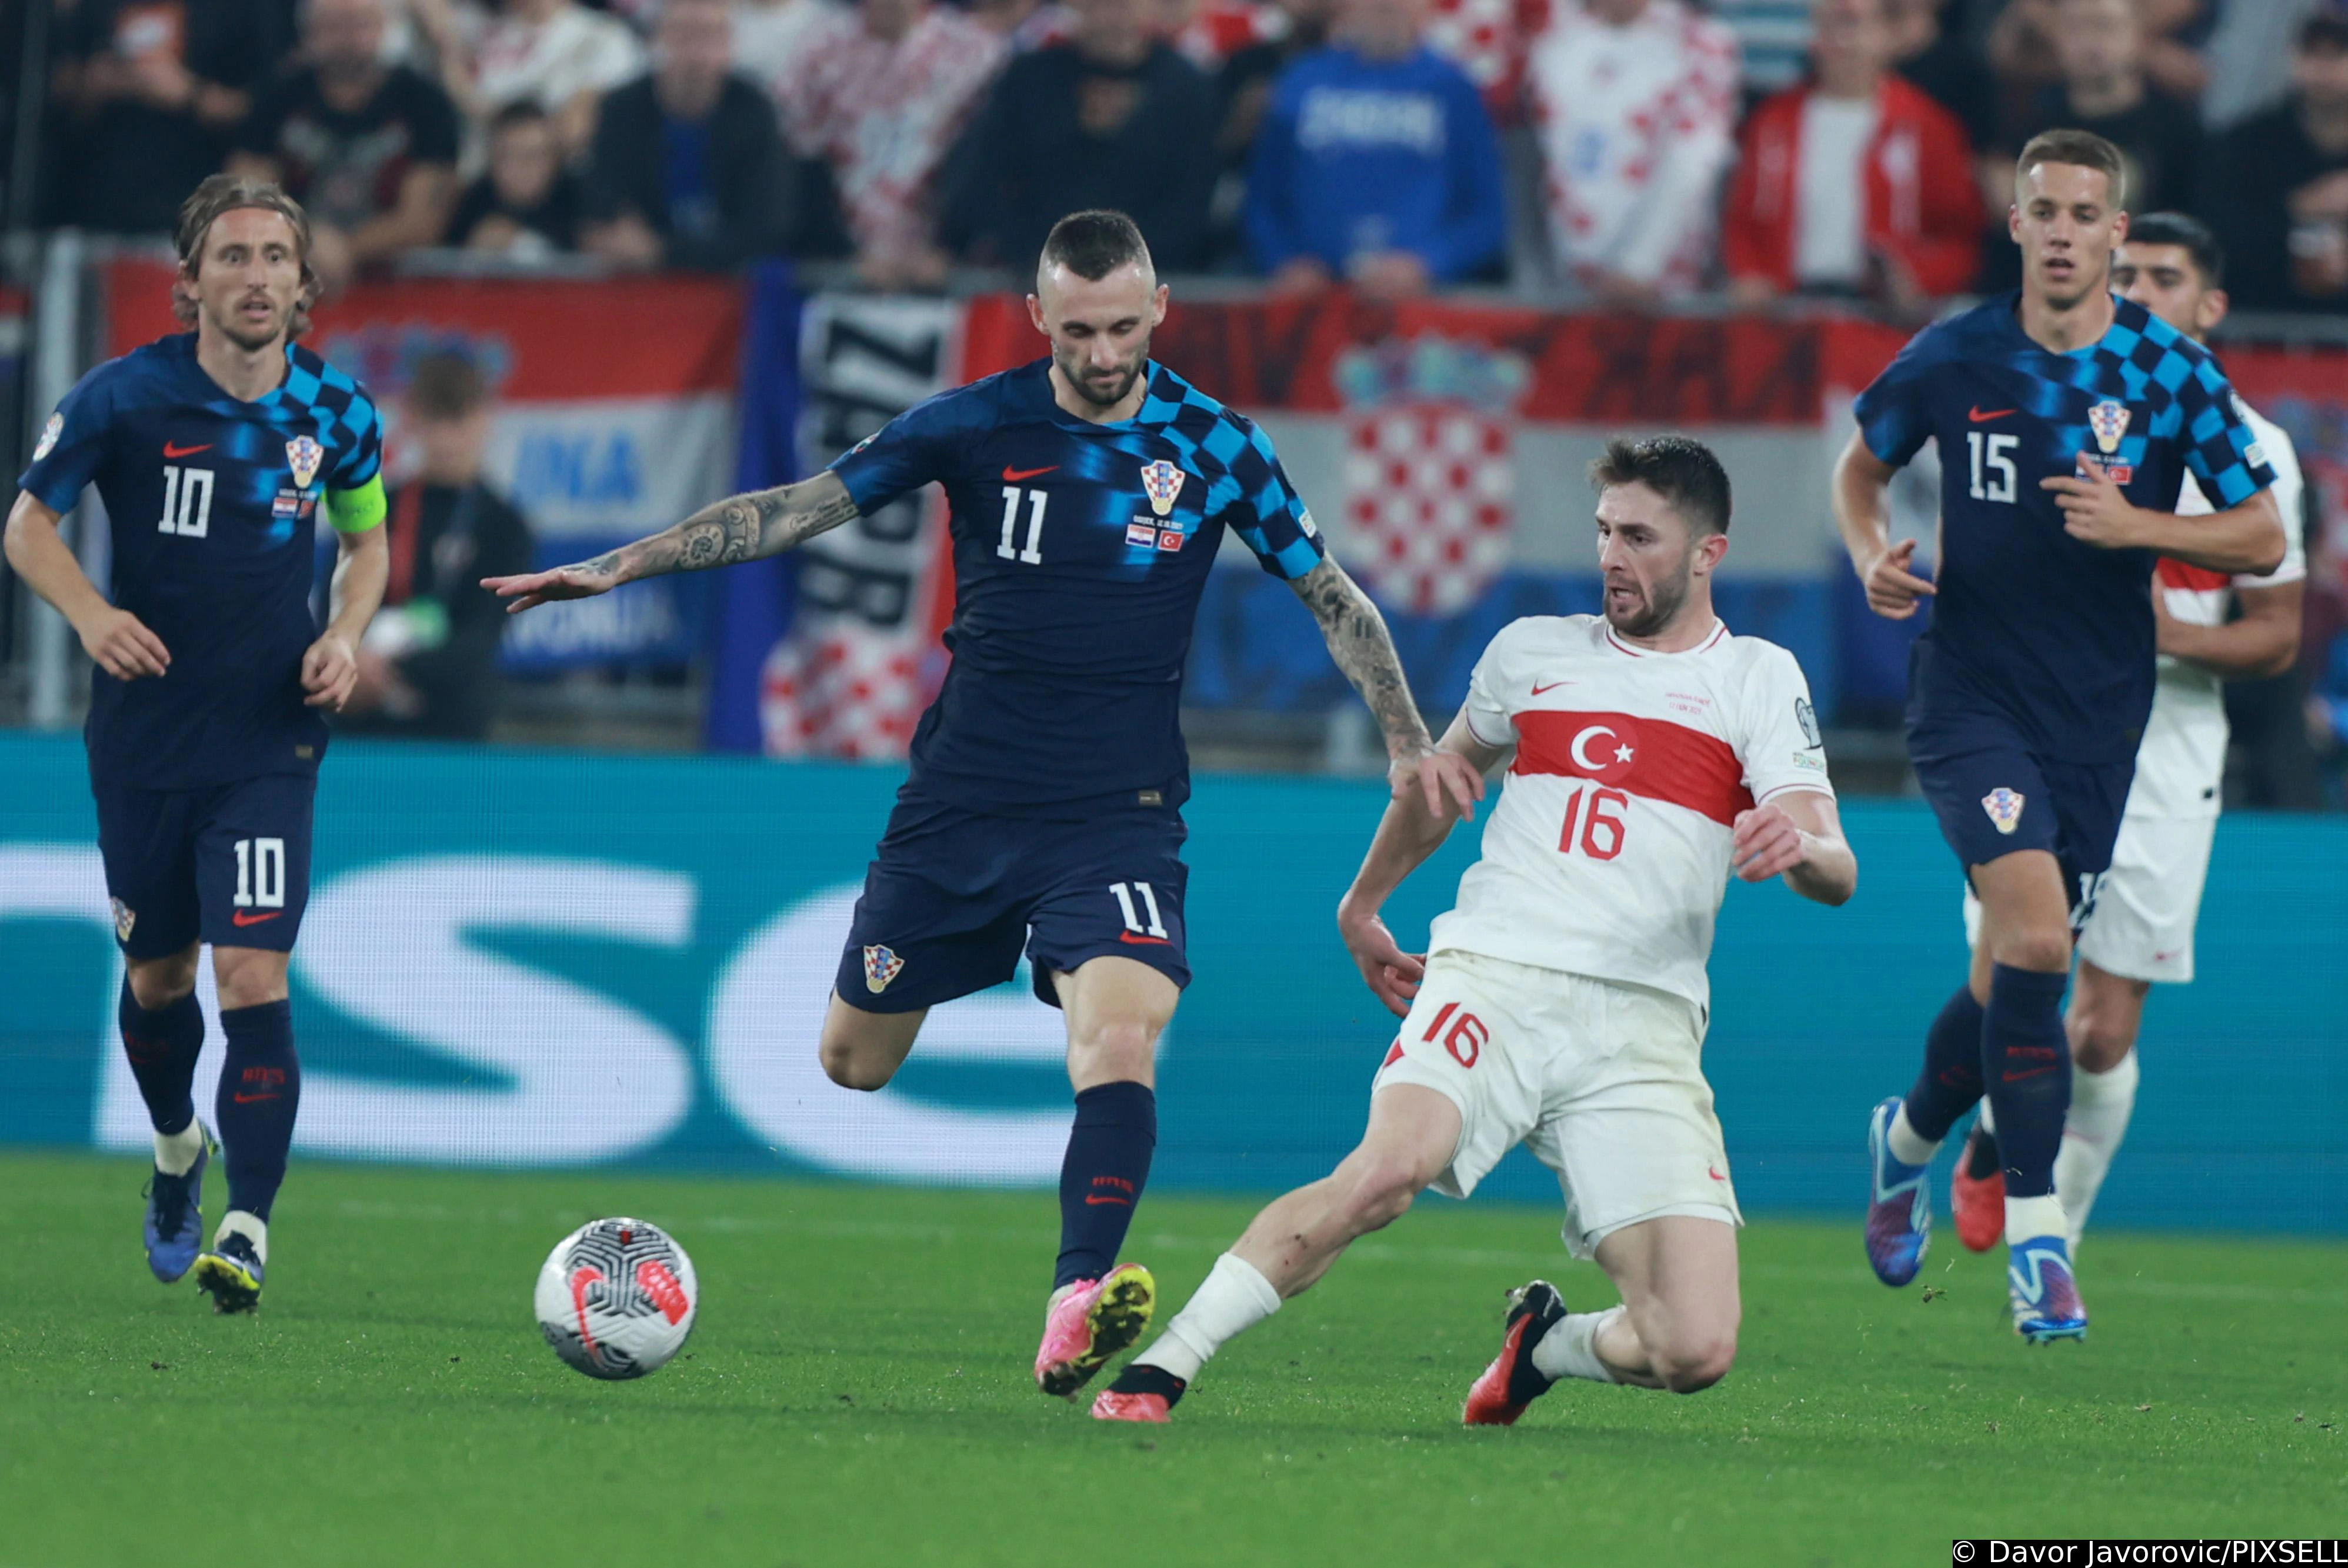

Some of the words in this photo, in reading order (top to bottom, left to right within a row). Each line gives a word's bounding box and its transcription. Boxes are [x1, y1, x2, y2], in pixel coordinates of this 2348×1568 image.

[158, 466, 215, 538] 10
[1967, 432, 2019, 504] 15
[996, 486, 1048, 565] 11
[1558, 786, 1628, 861] 16
[233, 838, 285, 908] 10
[1109, 882, 1169, 939] 11
[1423, 1002, 1489, 1069] 16
